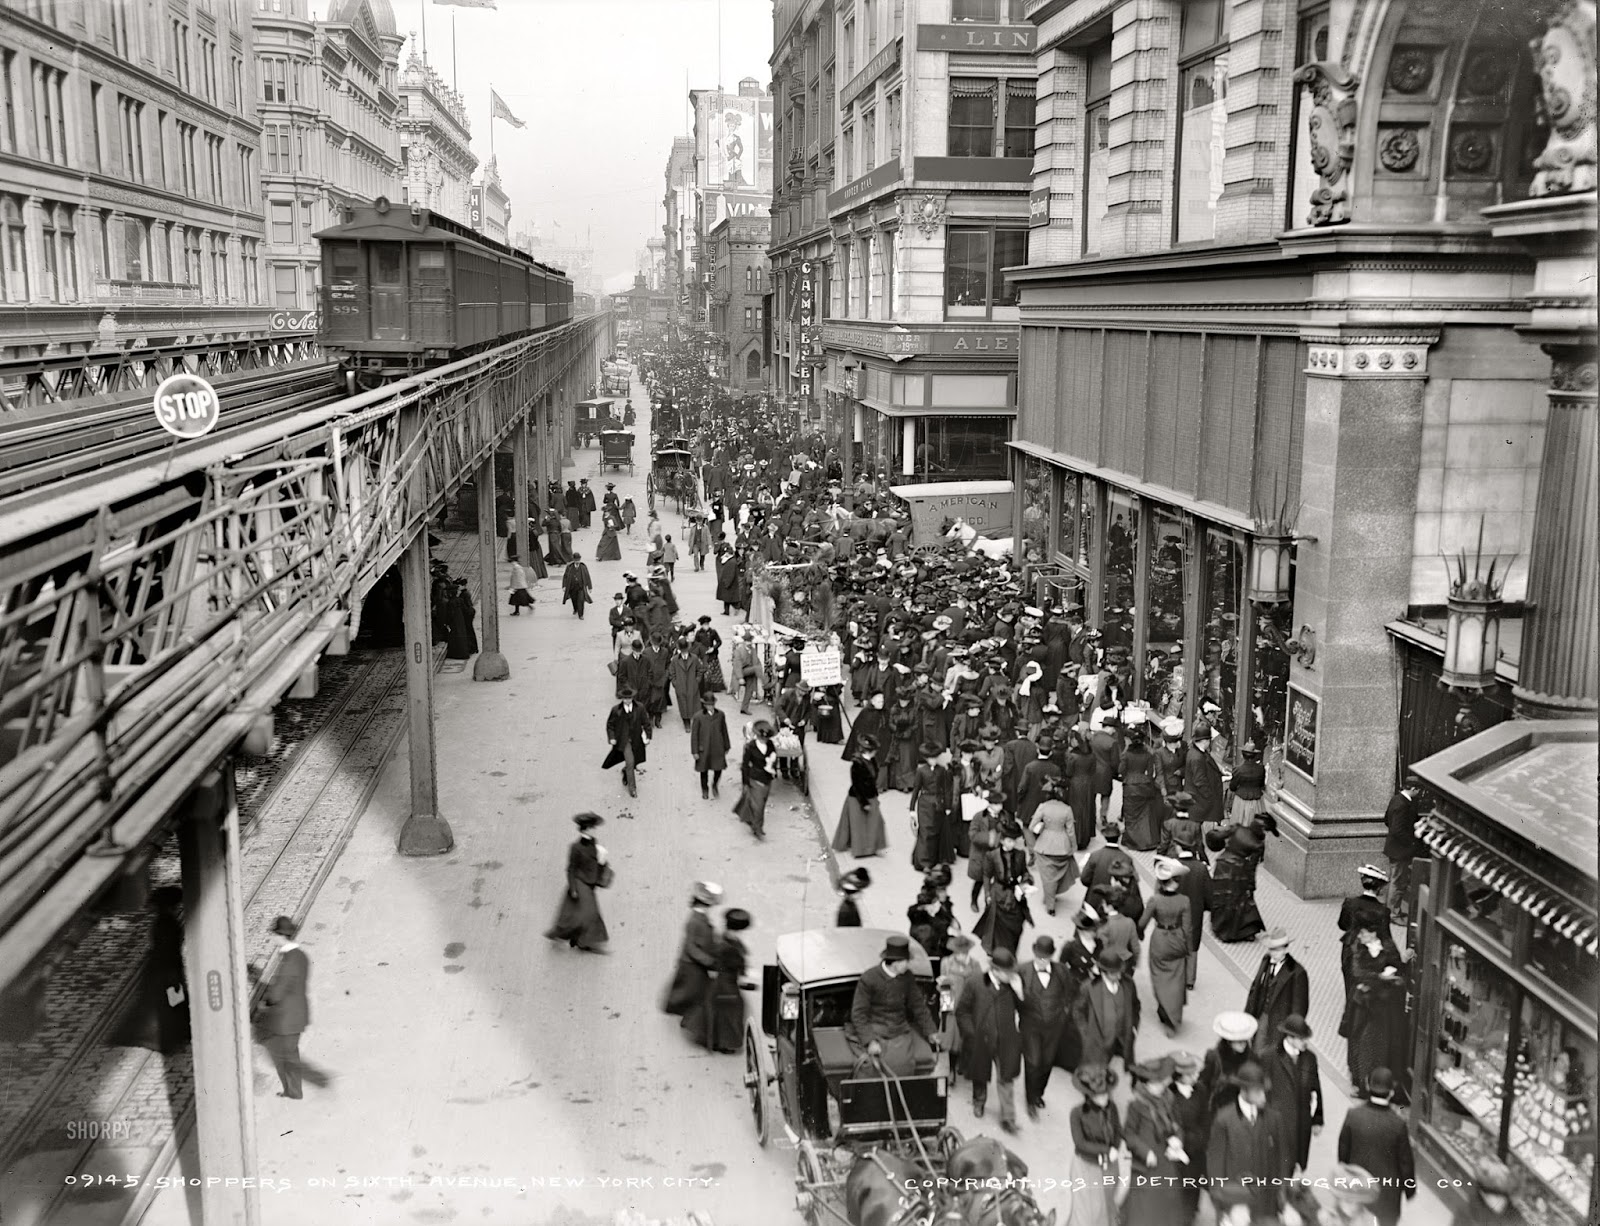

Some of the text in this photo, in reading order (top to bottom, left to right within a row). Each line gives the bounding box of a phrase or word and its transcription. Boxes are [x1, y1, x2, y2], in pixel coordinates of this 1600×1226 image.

[953, 337, 1020, 350] ALE
[161, 390, 211, 422] STOP
[929, 497, 998, 513] AMERICAN
